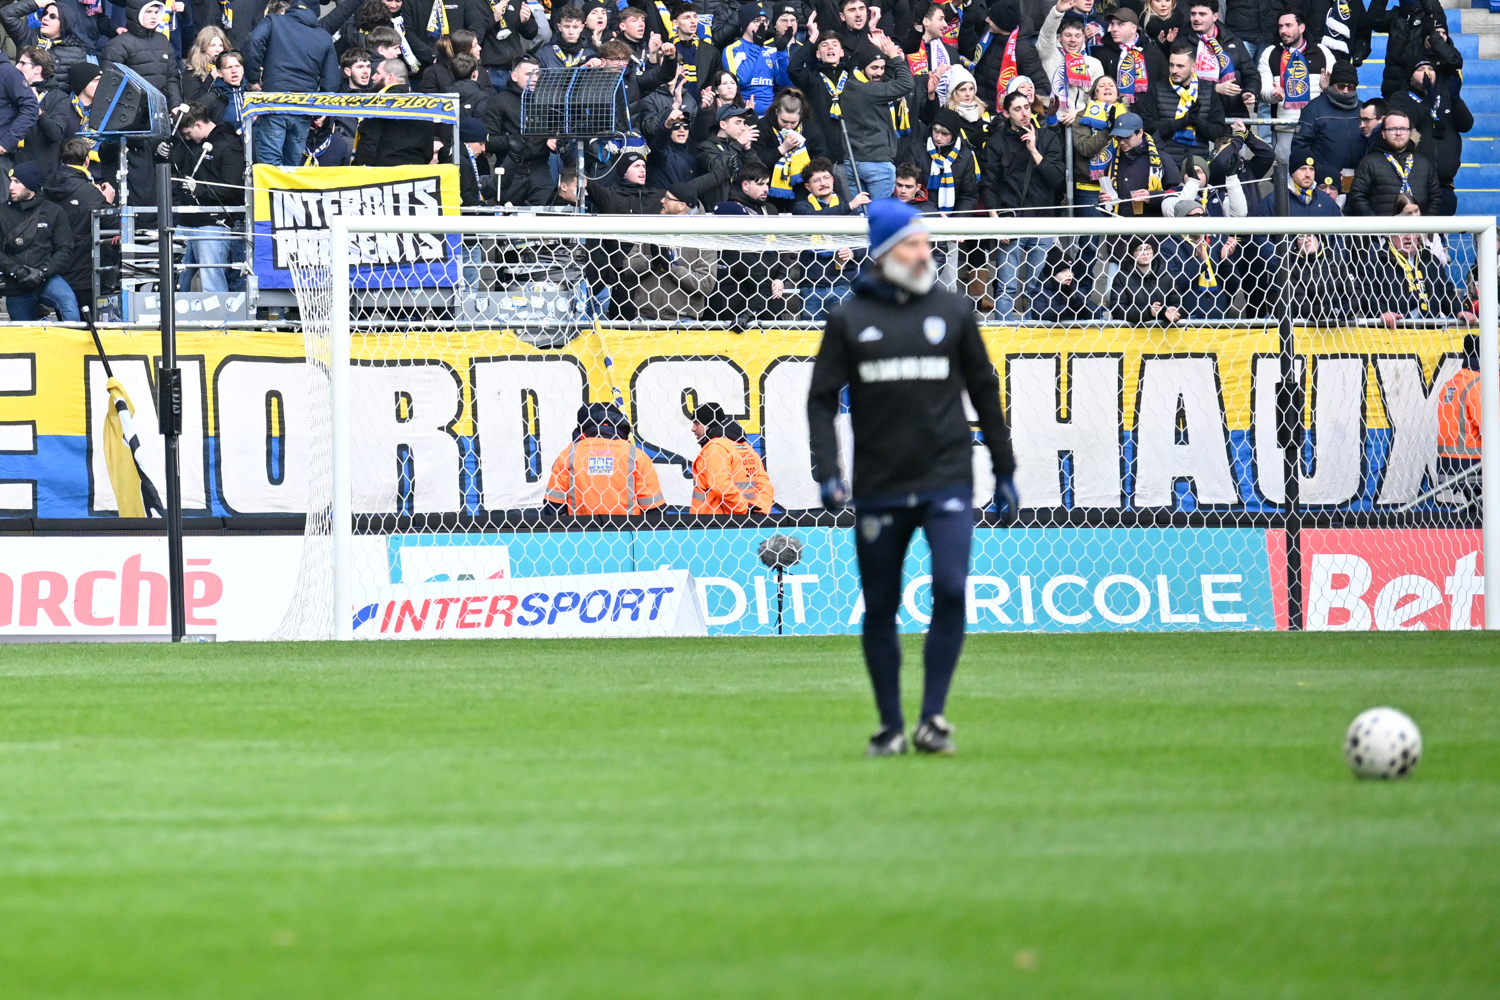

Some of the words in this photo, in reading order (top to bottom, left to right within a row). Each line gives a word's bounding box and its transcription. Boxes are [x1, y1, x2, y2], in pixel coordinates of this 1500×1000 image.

[273, 178, 439, 228] INTERDITS
[85, 353, 590, 518] NORD
[630, 353, 1466, 512] SOHAUX
[380, 587, 675, 634] INTERSPORT
